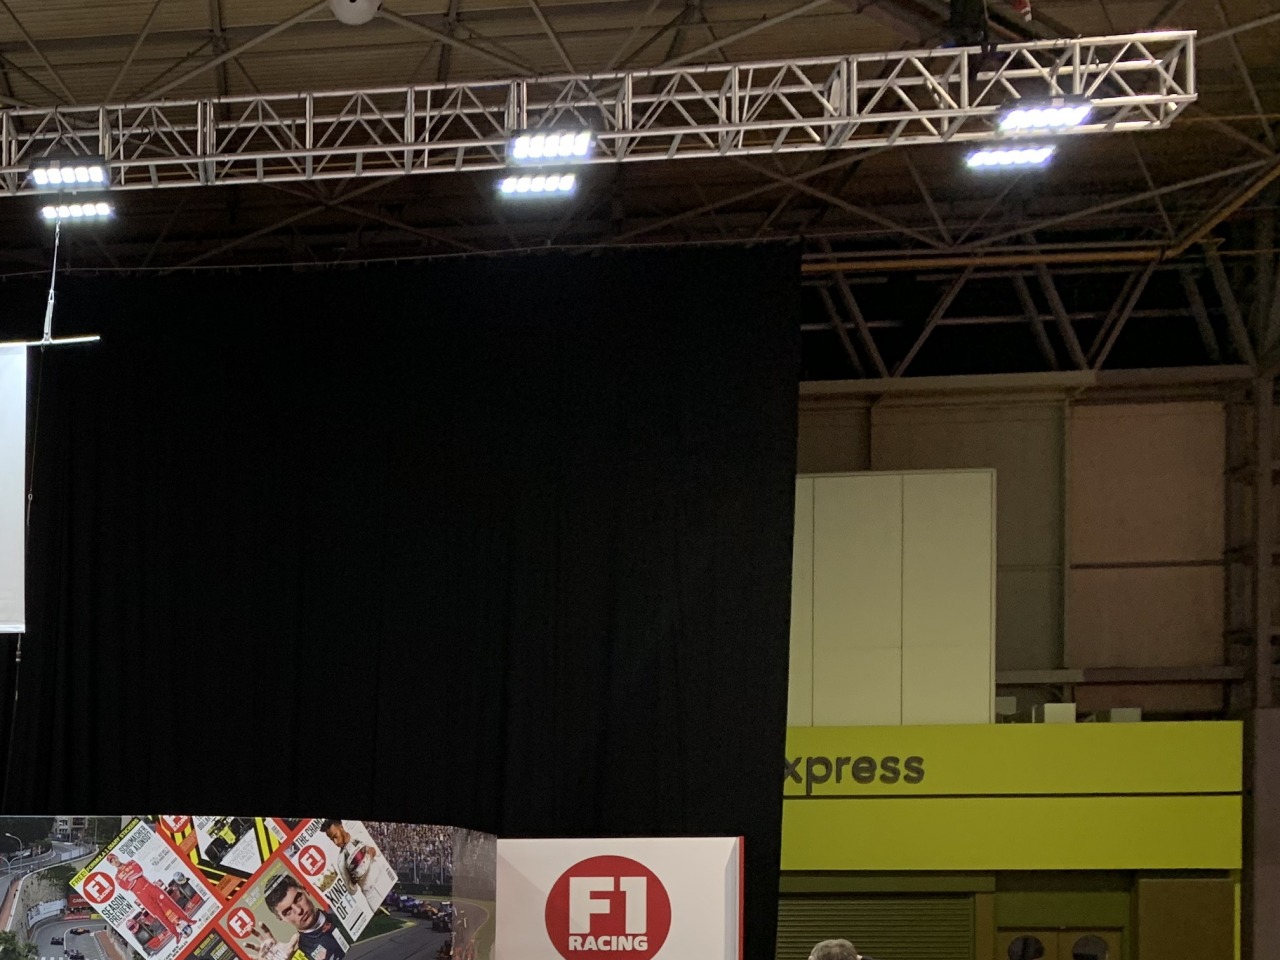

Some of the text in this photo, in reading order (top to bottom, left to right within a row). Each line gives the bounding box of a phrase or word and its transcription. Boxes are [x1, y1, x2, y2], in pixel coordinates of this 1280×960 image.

[119, 825, 148, 855] SCHUMACHER
[135, 831, 152, 852] ALONSO?
[296, 830, 310, 848] THE
[70, 869, 89, 887] FREE!
[87, 850, 107, 872] FORMULA
[120, 818, 140, 840] STICKERS
[300, 847, 323, 873] F1
[85, 874, 110, 901] F1
[325, 878, 349, 908] KING
[102, 893, 127, 919] SEASON
[109, 901, 134, 926] PREVIEW
[336, 902, 349, 920] OF
[568, 877, 647, 934] F1
[228, 909, 253, 935] F1
[568, 936, 648, 951] RACING
